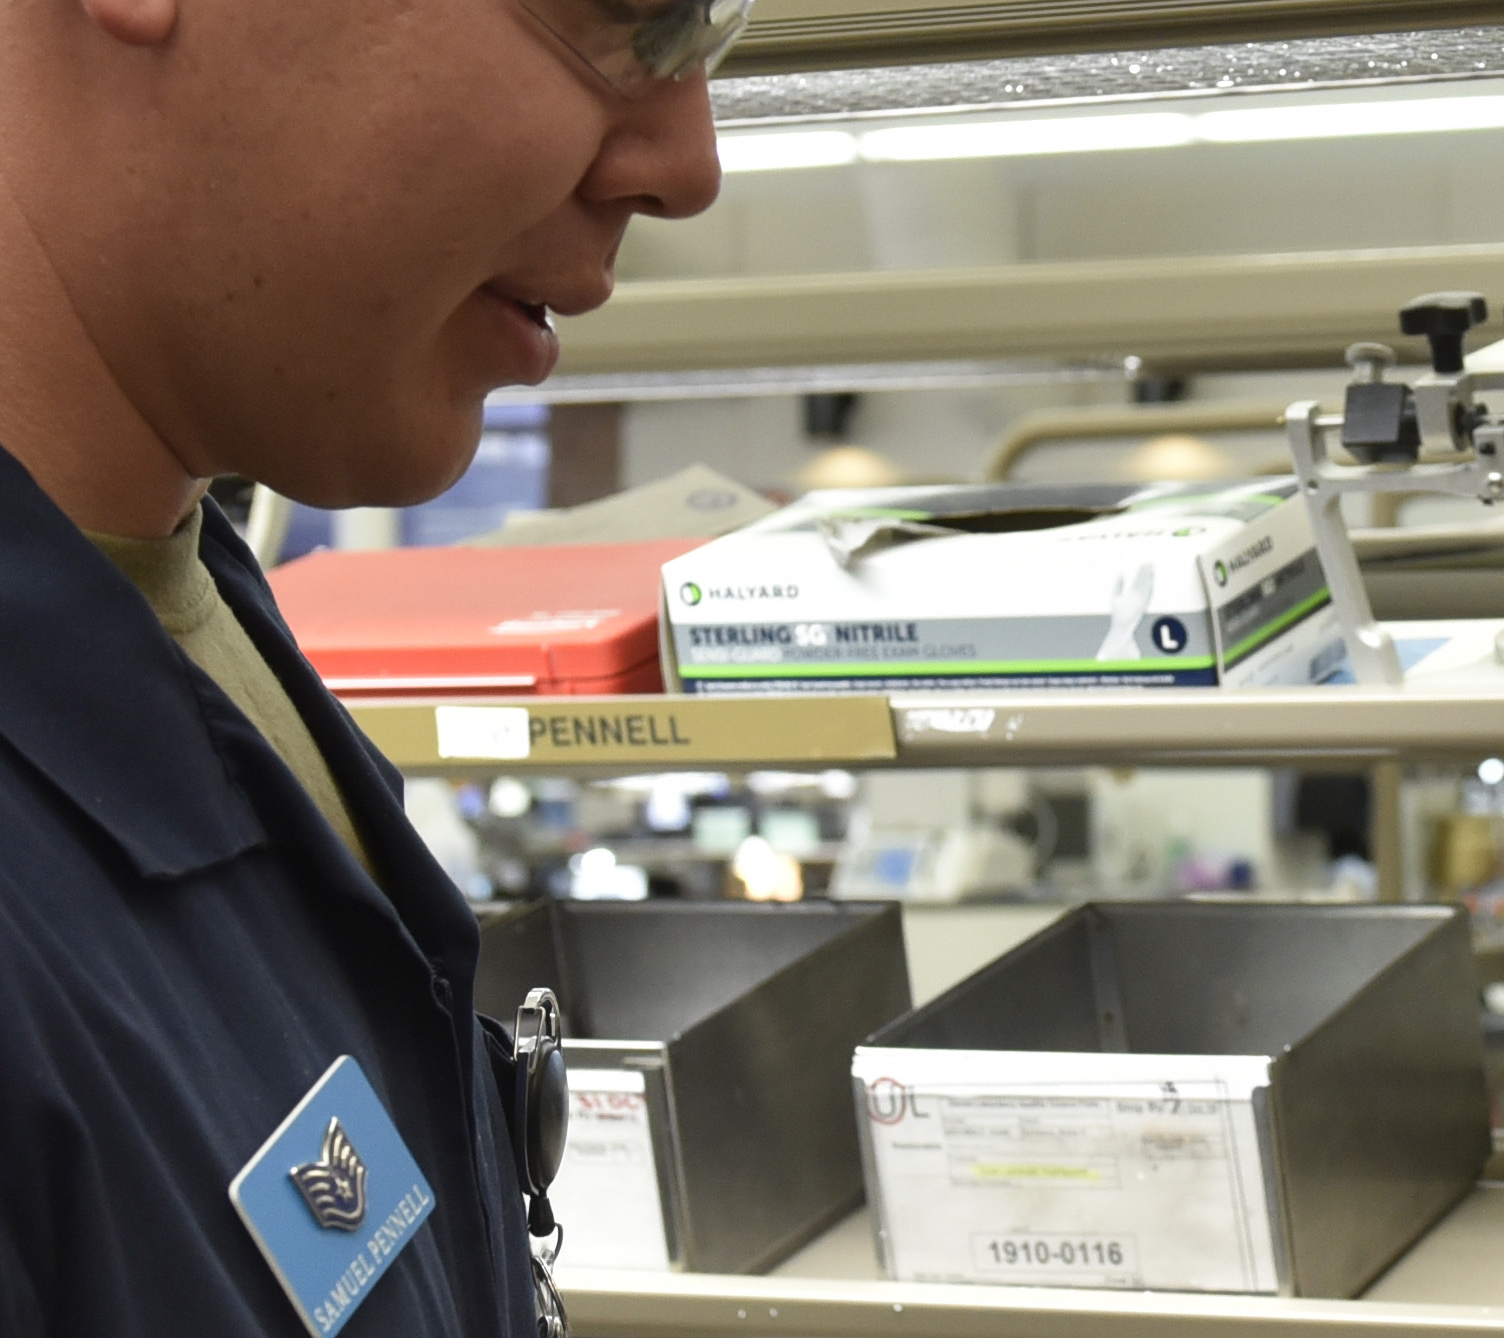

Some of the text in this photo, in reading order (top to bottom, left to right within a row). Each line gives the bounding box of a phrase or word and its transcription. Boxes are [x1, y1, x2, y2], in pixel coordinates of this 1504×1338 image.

[708, 584, 799, 599] HALYARD
[689, 625, 792, 646] STERLING
[835, 622, 918, 642] NITRILE
[1160, 624, 1178, 650] L
[529, 715, 690, 747] PENNELL
[313, 1183, 431, 1333] SAMUEL PENNELL
[988, 1240, 1124, 1266] 1910-0116
